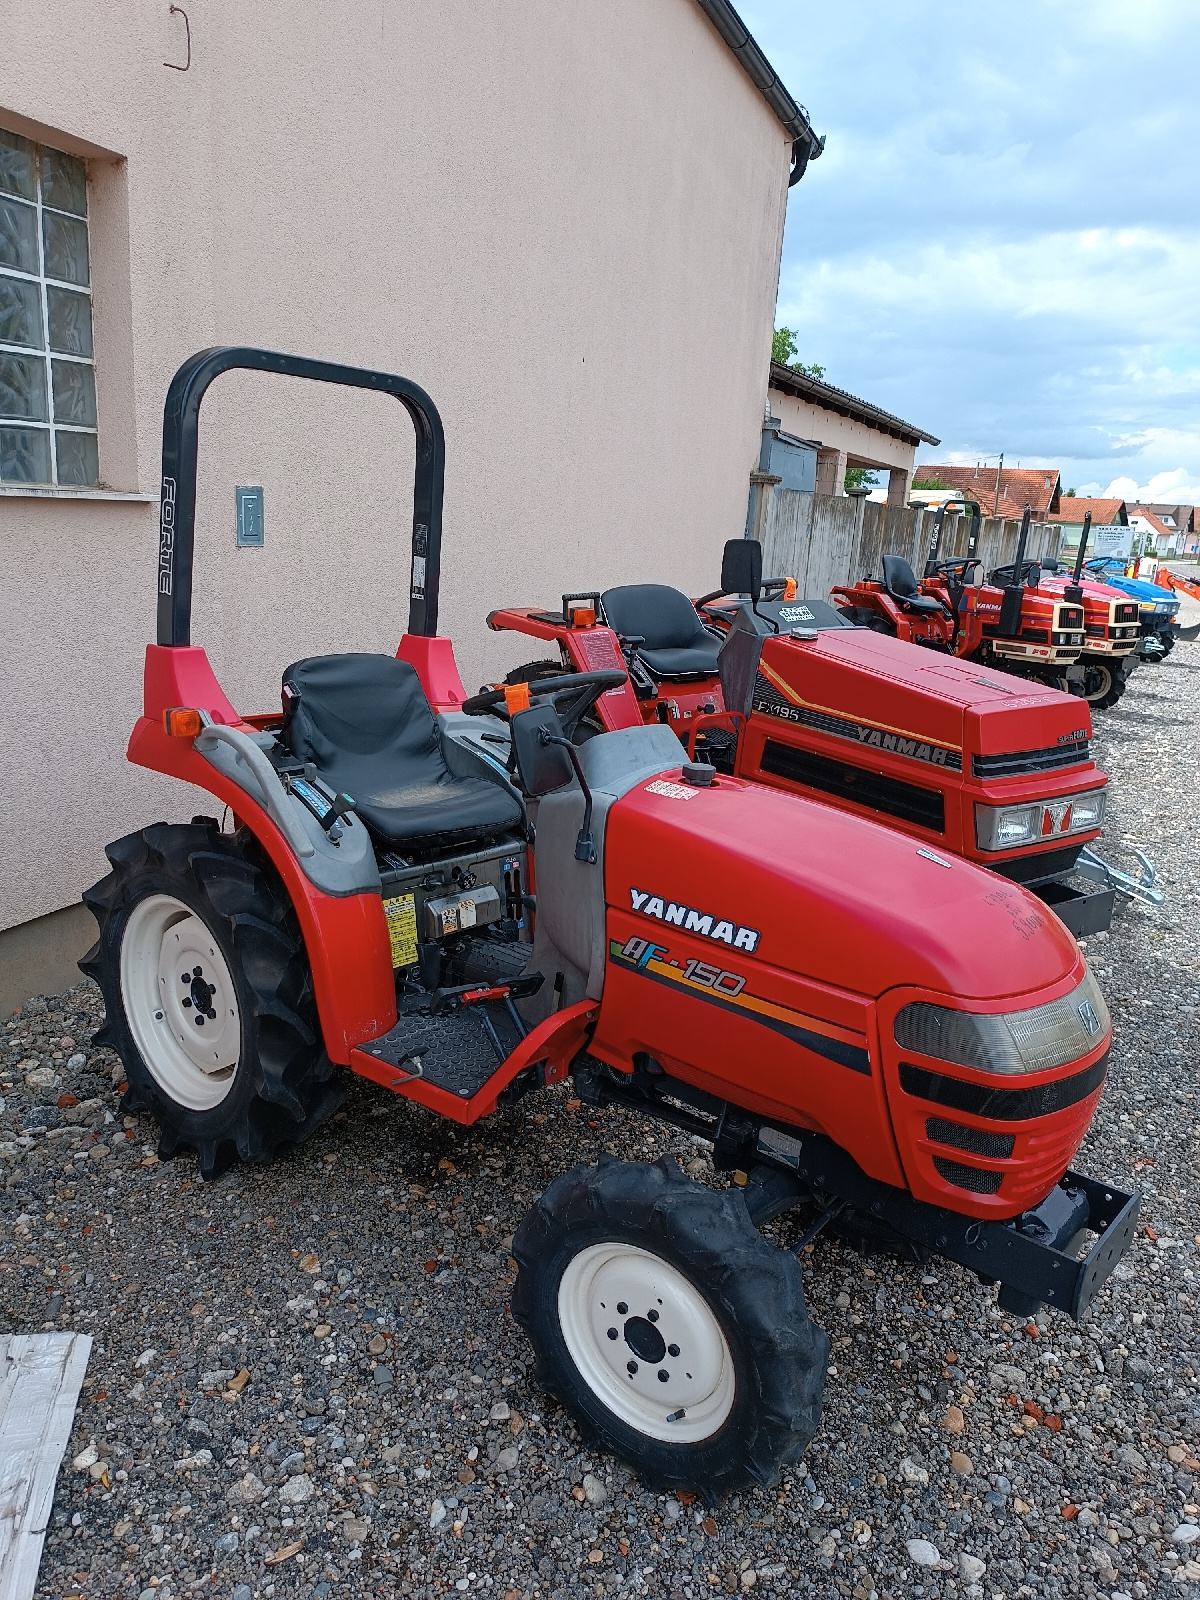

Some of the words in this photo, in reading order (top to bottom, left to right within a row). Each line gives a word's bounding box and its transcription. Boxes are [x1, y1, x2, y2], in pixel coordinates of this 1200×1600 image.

[159, 476, 177, 596] FORTE
[976, 602, 1002, 611] YANMA
[757, 701, 800, 721] FX195
[857, 726, 948, 765] YANMAR
[630, 888, 761, 953] YANMAR
[621, 936, 748, 997] AF-150
